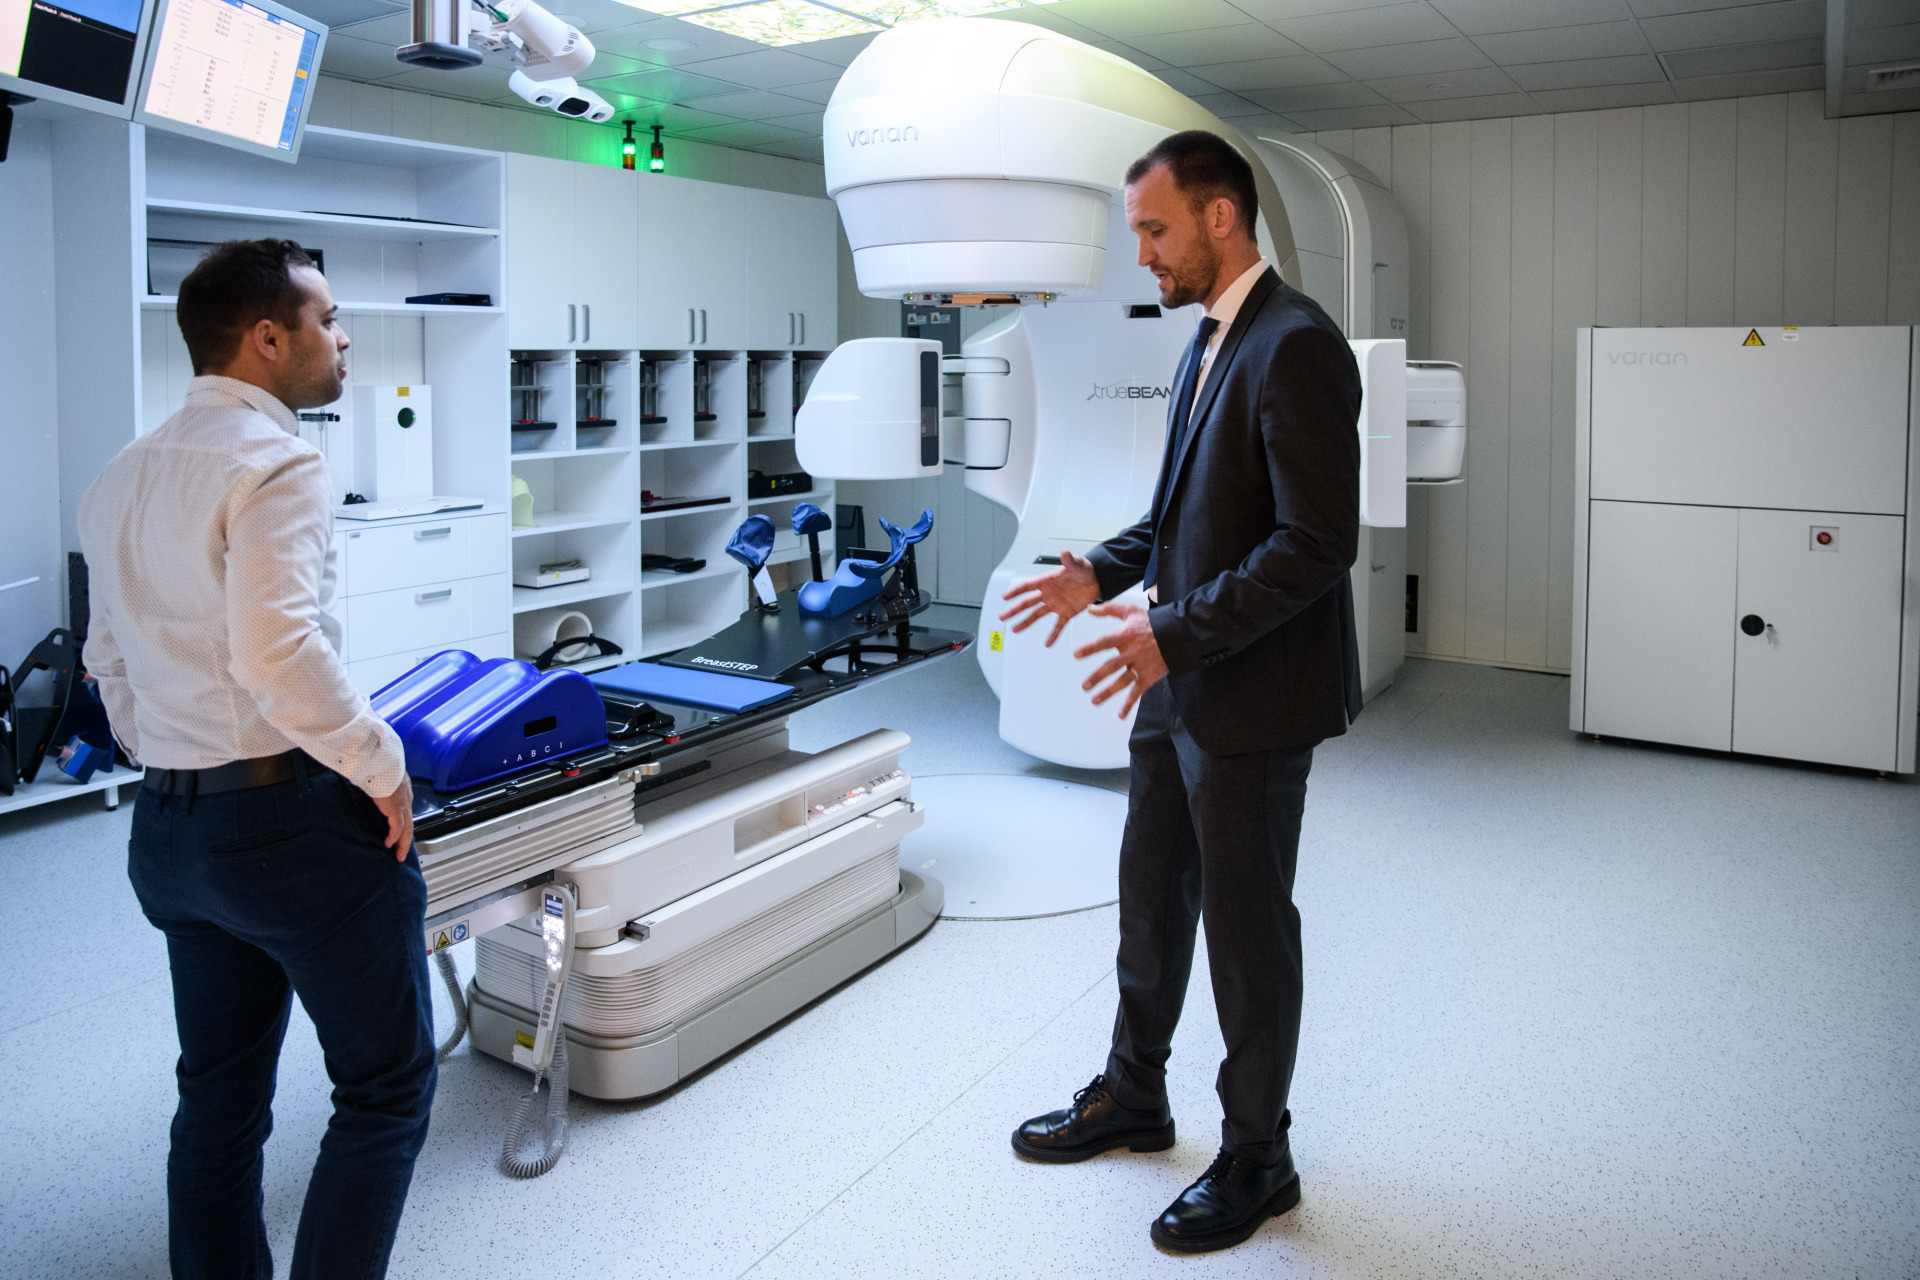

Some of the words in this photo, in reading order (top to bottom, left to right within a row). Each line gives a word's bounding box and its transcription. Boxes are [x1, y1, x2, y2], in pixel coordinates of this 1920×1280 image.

[847, 126, 919, 147] varian
[1607, 351, 1688, 366] varian
[691, 656, 759, 671] BreastSTEP
[517, 754, 523, 762] A
[531, 749, 537, 758] B
[544, 745, 551, 753] C
